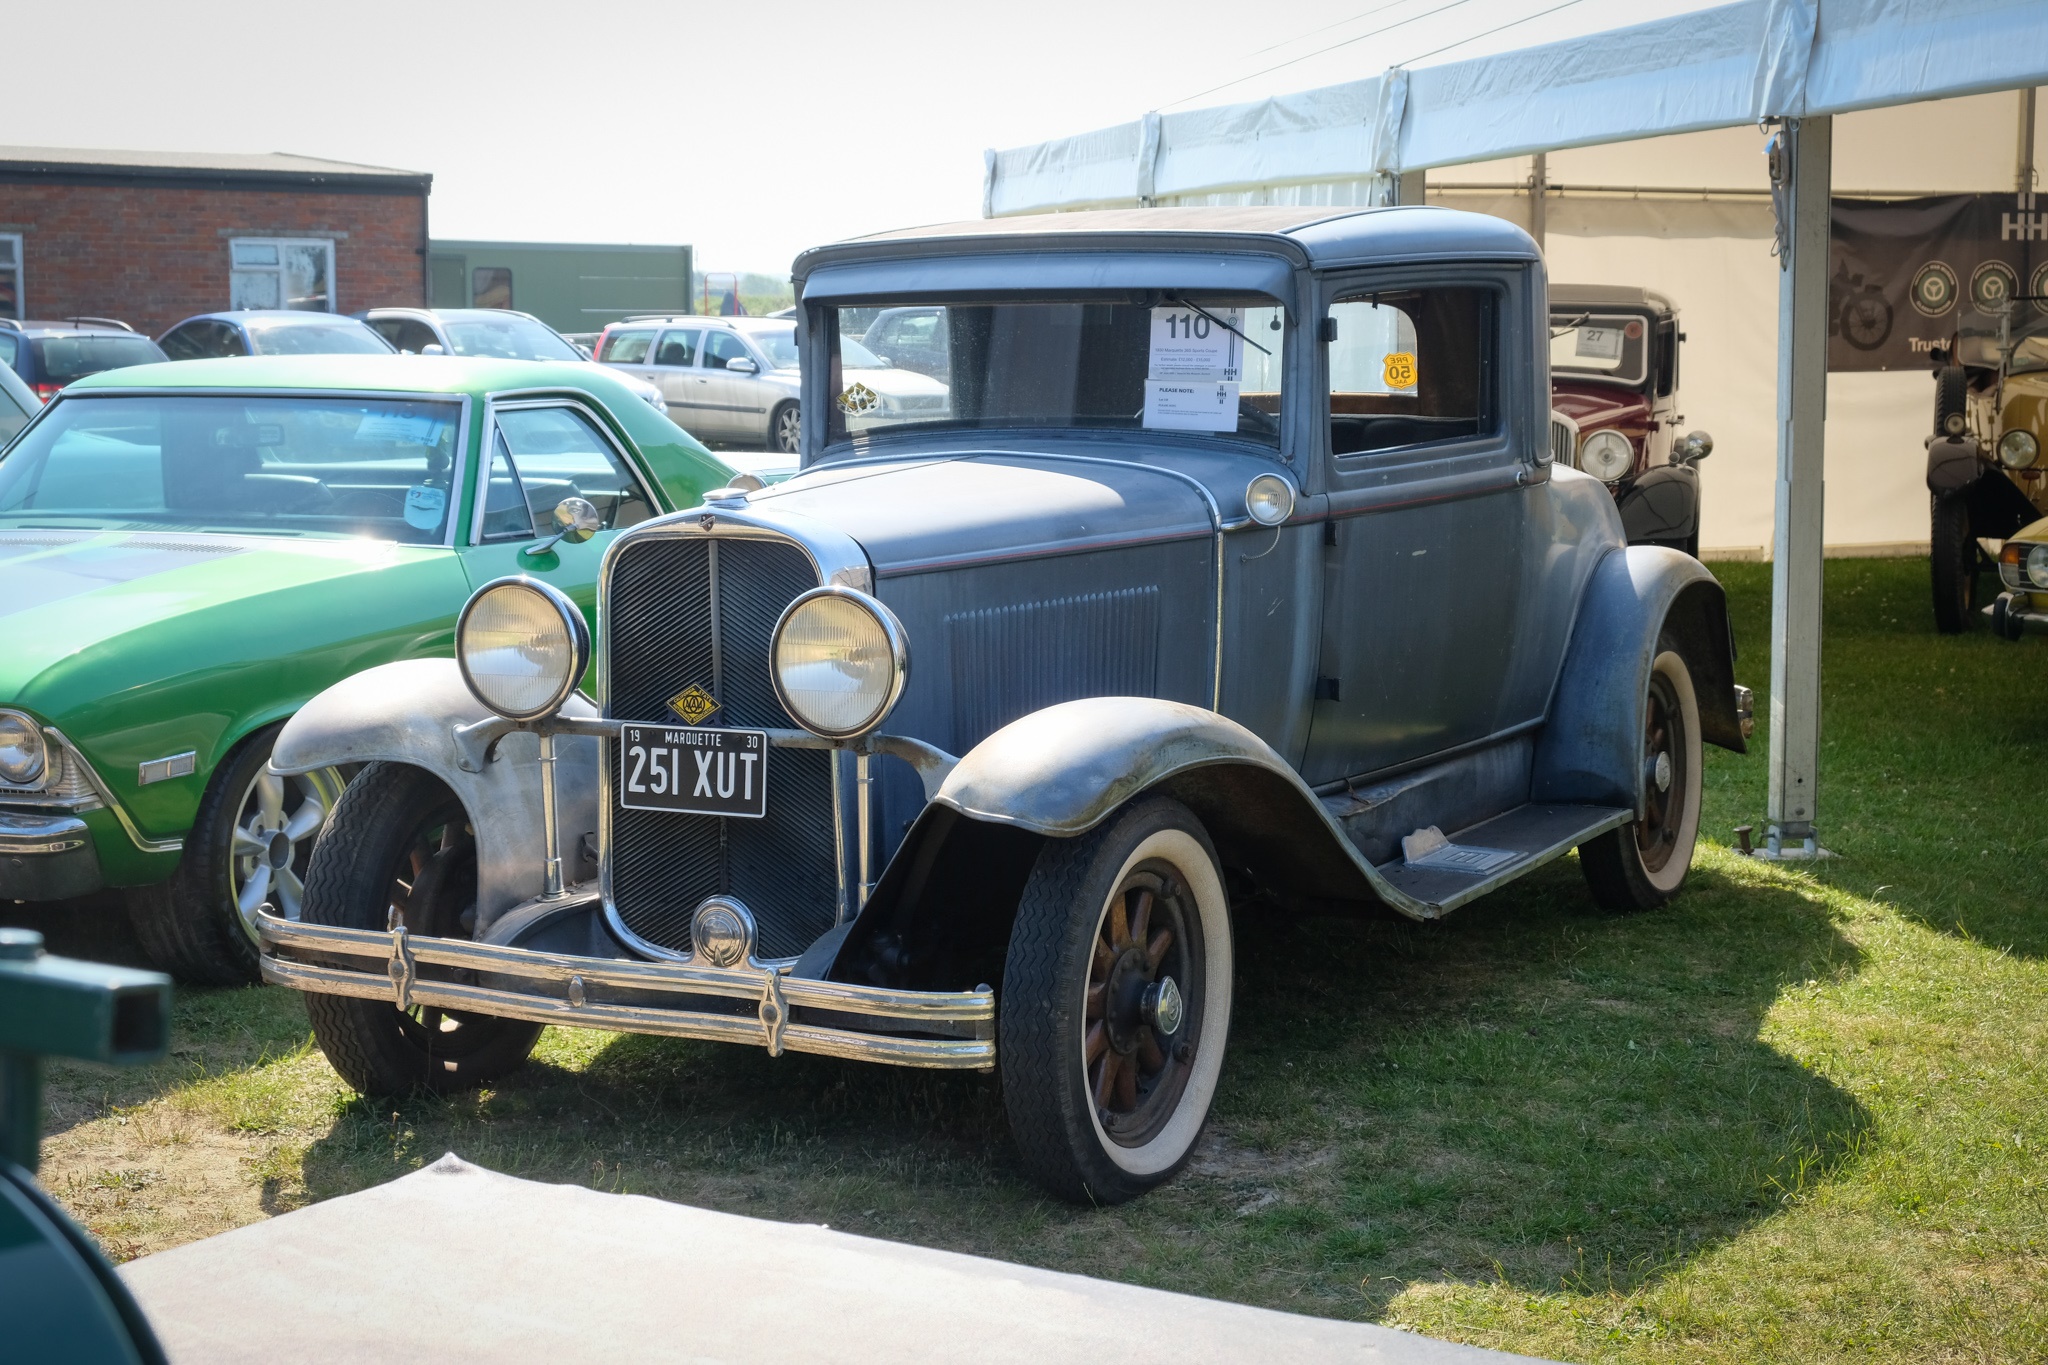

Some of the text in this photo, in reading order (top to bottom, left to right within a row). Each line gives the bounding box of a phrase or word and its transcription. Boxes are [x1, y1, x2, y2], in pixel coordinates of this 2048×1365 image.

[1165, 313, 1211, 340] 110
[1586, 330, 1604, 342] 27
[673, 687, 712, 703] CALIFORNIA STATE
[629, 729, 758, 749] 19 MARQUETTE 30
[628, 745, 758, 800] 251 XUT
